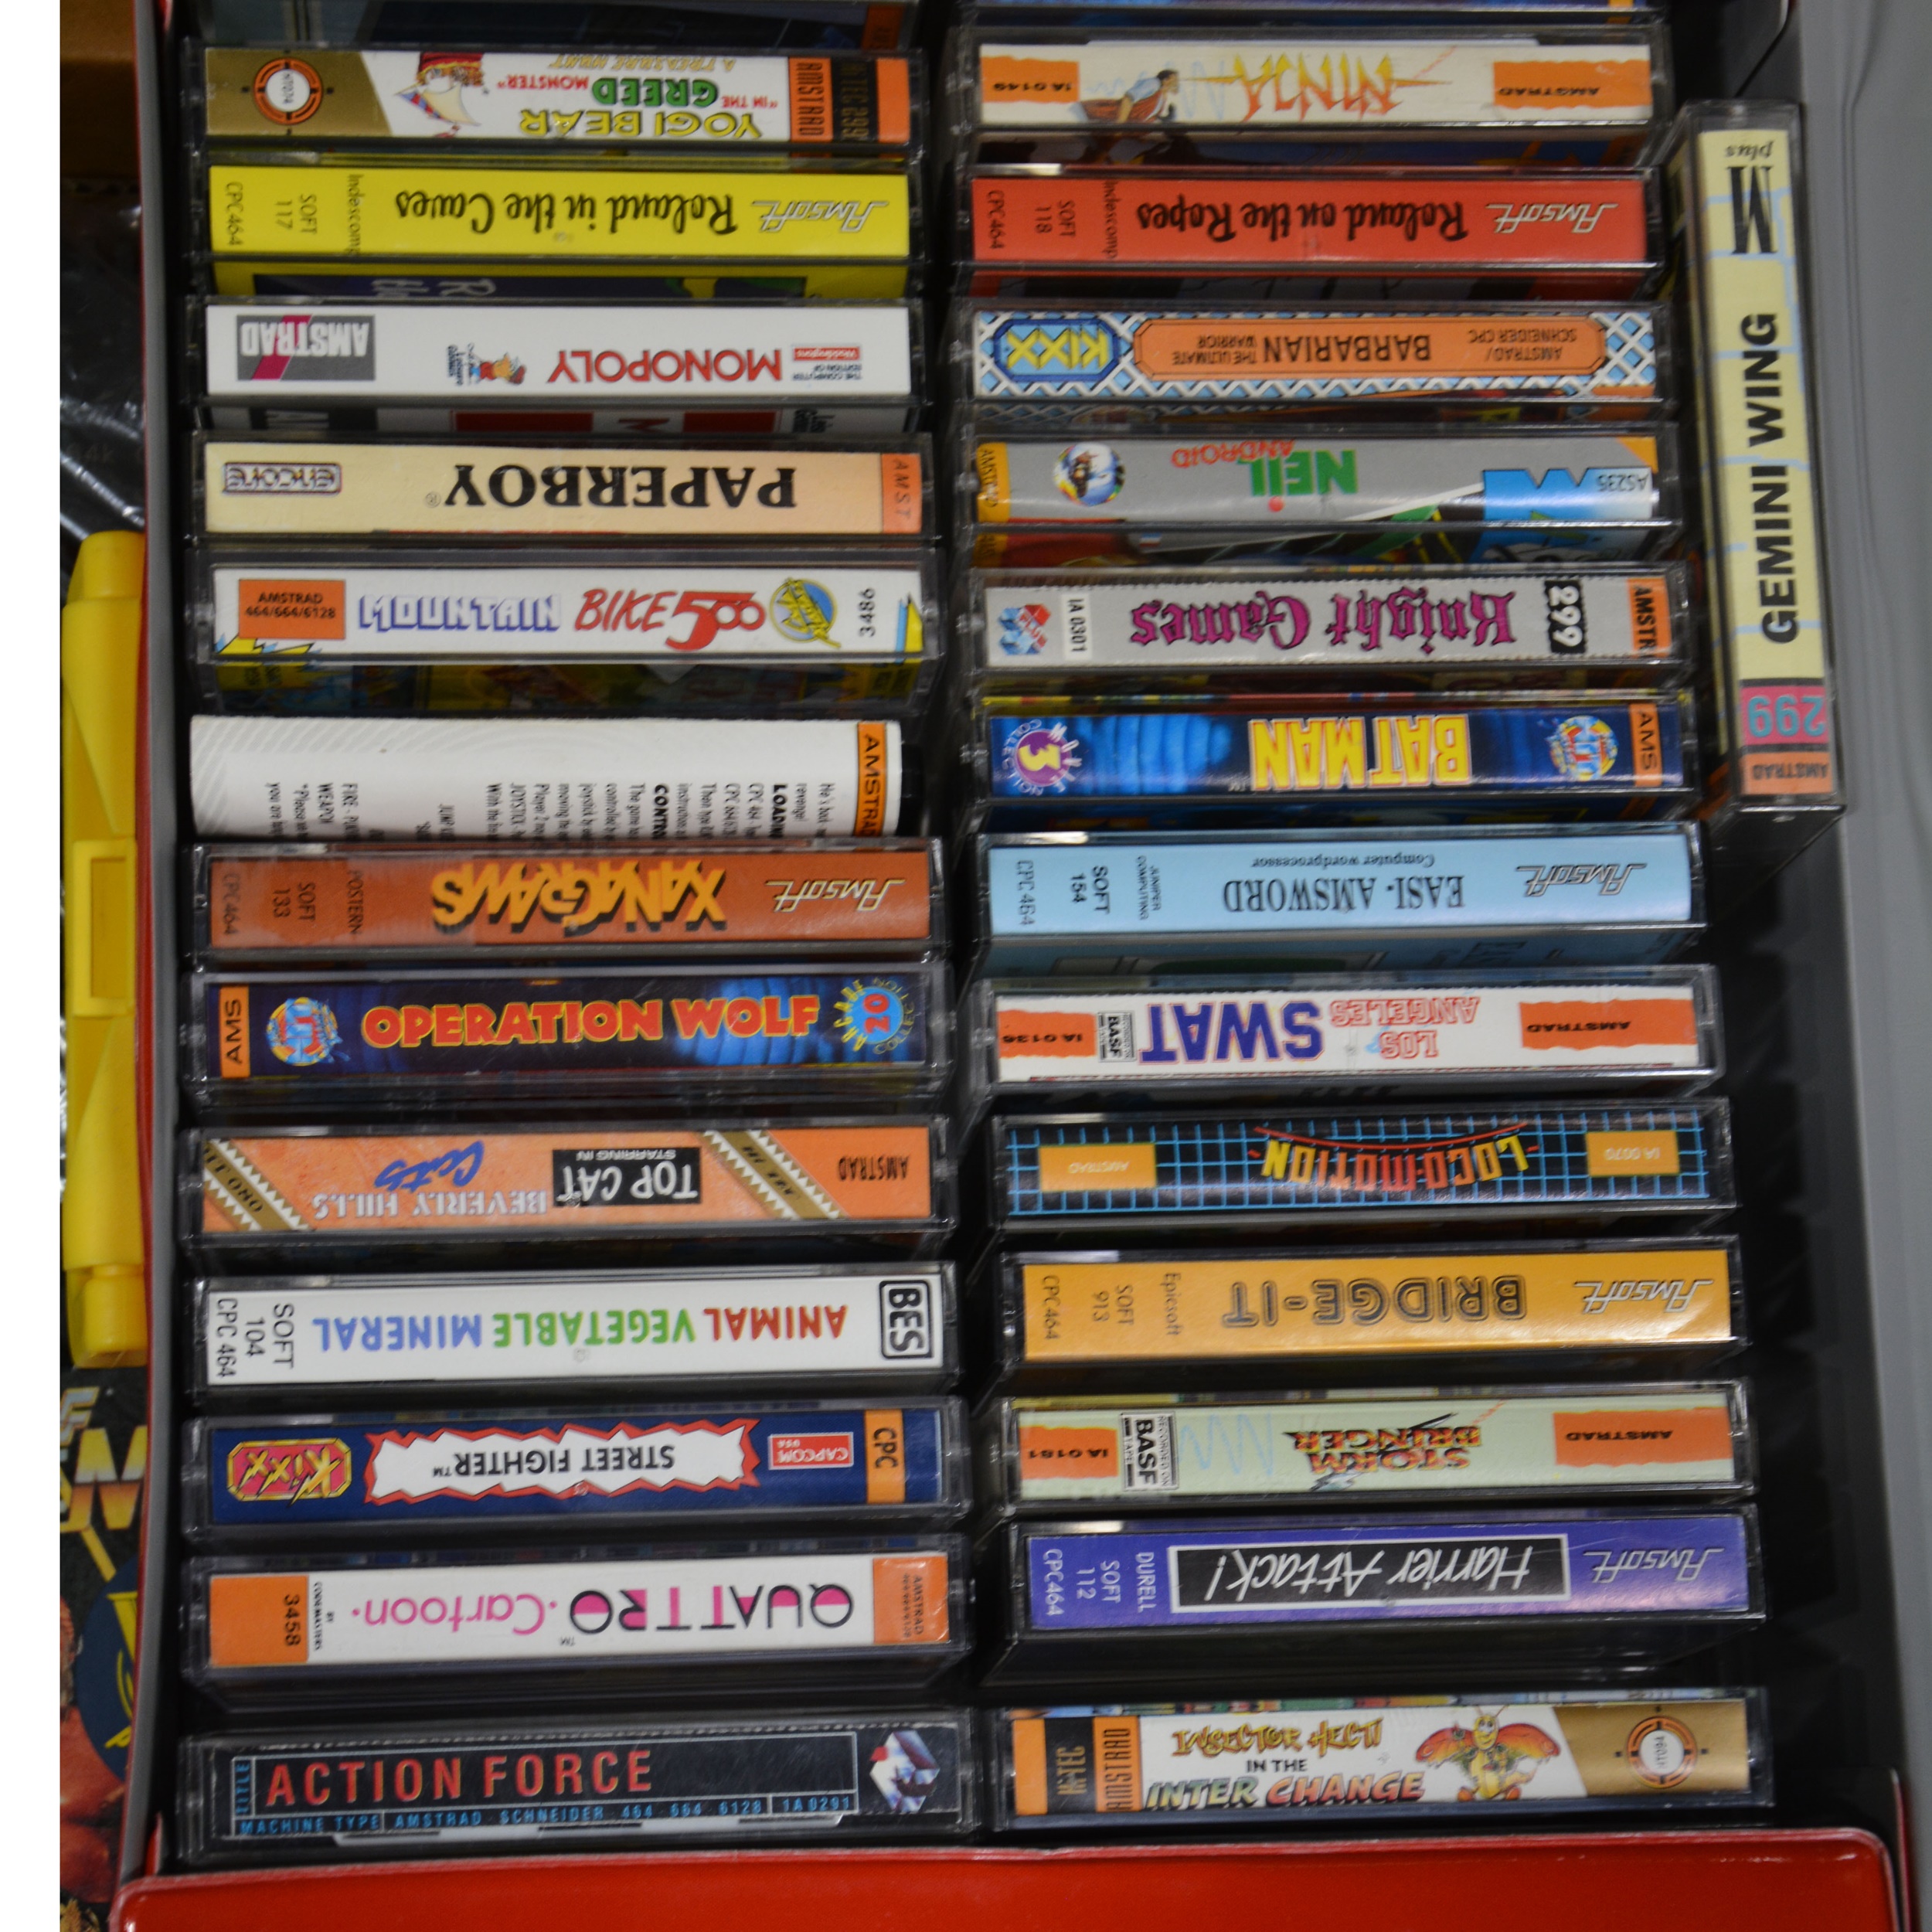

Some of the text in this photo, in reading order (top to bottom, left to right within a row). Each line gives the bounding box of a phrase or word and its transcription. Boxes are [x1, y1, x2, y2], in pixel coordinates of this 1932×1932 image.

[547, 55, 617, 71] HUNT
[623, 56, 715, 72] TREASURE
[593, 79, 718, 107] GREED
[721, 96, 747, 108] THE
[798, 63, 823, 137] AMSTRAD
[993, 83, 1046, 92] 0149
[1233, 53, 1406, 124] NINJA
[1499, 87, 1600, 96] AMSTRAD
[519, 110, 762, 138] YOGI BEAR
[1724, 139, 1774, 159] plus
[275, 200, 293, 230] 117
[299, 194, 317, 234] SOFT
[396, 192, 737, 236] Roland in the Caves
[752, 200, 888, 233] Amsoft
[1036, 206, 1052, 233] 118
[1059, 200, 1074, 236] SOFT
[1102, 180, 1118, 259] Indescomp
[1137, 195, 1468, 242] Roland on the Ropes
[1486, 204, 1617, 233] Amsoft
[240, 322, 369, 356] AMSTRAD
[1006, 328, 1107, 369] KIXX
[1198, 335, 1257, 349] WARRIOR
[1263, 334, 1431, 364] BARBARIAN
[1468, 329, 1577, 344] SCHNEIDER CPC
[547, 349, 782, 383] MONOPOLY
[1172, 351, 1257, 365] THE ULTIMATE
[1171, 440, 1294, 468] ANDROID
[225, 466, 335, 492] encore
[895, 458, 910, 519] AMST
[1236, 450, 1359, 512] NEIL
[1596, 474, 1648, 492] AS235
[1740, 312, 1800, 644] GEMINI WING
[259, 593, 322, 602] AMSTRAD
[359, 594, 560, 631] MOUNTAIN
[574, 590, 677, 631] BIKE
[858, 588, 875, 638] 3486
[1131, 586, 1517, 655] Knight Games
[1549, 585, 1582, 647] 299
[1070, 617, 1086, 652] 0301
[1748, 696, 1825, 738] 299
[1018, 743, 1061, 771] 3
[1247, 714, 1471, 791] BATMAN
[1639, 713, 1653, 770] AMS
[860, 735, 880, 837] AMSTRA
[1752, 763, 1828, 781] AMSTRAD
[1251, 852, 1435, 869] Computer wordprocessor
[764, 879, 905, 912] Amsoft
[1070, 873, 1087, 903] 154
[1092, 866, 1108, 914] SOFT
[1223, 876, 1377, 913] AMSWORD
[1516, 864, 1646, 896] Amsoft
[272, 889, 291, 918] 133
[298, 883, 315, 922] SOFT
[348, 870, 363, 935] POSTERN
[430, 859, 728, 938] XANAGRAMS
[360, 999, 663, 1049] OPERATION
[671, 995, 820, 1040] WOLF
[1329, 995, 1479, 1027] ANGELES
[1527, 1021, 1631, 1033] AMSTRAD
[225, 998, 243, 1066] AMS
[1002, 1034, 1057, 1043] 0136
[1108, 1015, 1123, 1057] BASF
[1139, 1000, 1324, 1064] SWAT
[1379, 1029, 1437, 1059] LOS
[374, 1141, 485, 1194] Cats
[576, 1149, 675, 1161] STARRING IN
[838, 1155, 908, 1181] AMSTRAD
[1069, 1162, 1130, 1174] AMSTRAD
[1605, 1147, 1640, 1161] 0070
[557, 1165, 624, 1202] CAT
[631, 1162, 699, 1199] TOP
[312, 1190, 546, 1219] BEVERLY HILLS
[1092, 1291, 1110, 1322] 913
[1116, 1285, 1133, 1325] SOFT
[1221, 1275, 1528, 1329] BRIDGE-IT
[1574, 1279, 1713, 1313] Amsoft
[216, 1298, 237, 1377] CPC 464
[246, 1318, 265, 1357] 104
[274, 1304, 293, 1369] SOFT
[312, 1304, 848, 1352] ANIMAL VEGETABLE MINERAL
[889, 1287, 924, 1353] BES
[777, 1439, 801, 1449] USA
[874, 1428, 897, 1469] CPC
[1124, 1437, 1134, 1464] TAPE
[1136, 1419, 1158, 1484] BASF
[1157, 1416, 1170, 1487] RECORDED ON
[1287, 1427, 1482, 1451] BRINGER
[1566, 1430, 1673, 1442] AMSTRAD
[582, 1445, 675, 1472] STREET
[777, 1447, 849, 1463] CAPCOM
[1028, 1449, 1083, 1460] 0181
[1309, 1447, 1471, 1475] STORM
[1100, 1560, 1120, 1603] SOFT
[1135, 1552, 1156, 1613] DURELL
[1204, 1546, 1532, 1602] Harrier Attack!
[1583, 1547, 1724, 1583] Amsoft
[1077, 1568, 1095, 1600] 112
[284, 1594, 301, 1647] 3458
[569, 1583, 854, 1634] QUATTRO
[913, 1576, 923, 1635] AMSTRAD
[1171, 1716, 1384, 1758] INSECTOR HECTI
[266, 1750, 651, 1807] ACTION FORCE
[1104, 1727, 1131, 1811] AMSTRAD
[1247, 1759, 1308, 1773] IN THE
[1145, 1770, 1426, 1811] INTER CHANGE
[240, 1816, 324, 1835] MACHINE
[335, 1814, 380, 1831] TYPE
[395, 1811, 482, 1828] AMSTRAD
[500, 1806, 604, 1825] SCHNEIDER
[621, 1804, 653, 1819] 464
[670, 1802, 702, 1817] 664
[719, 1800, 762, 1815] 6128
[808, 1795, 850, 1811] 0291
